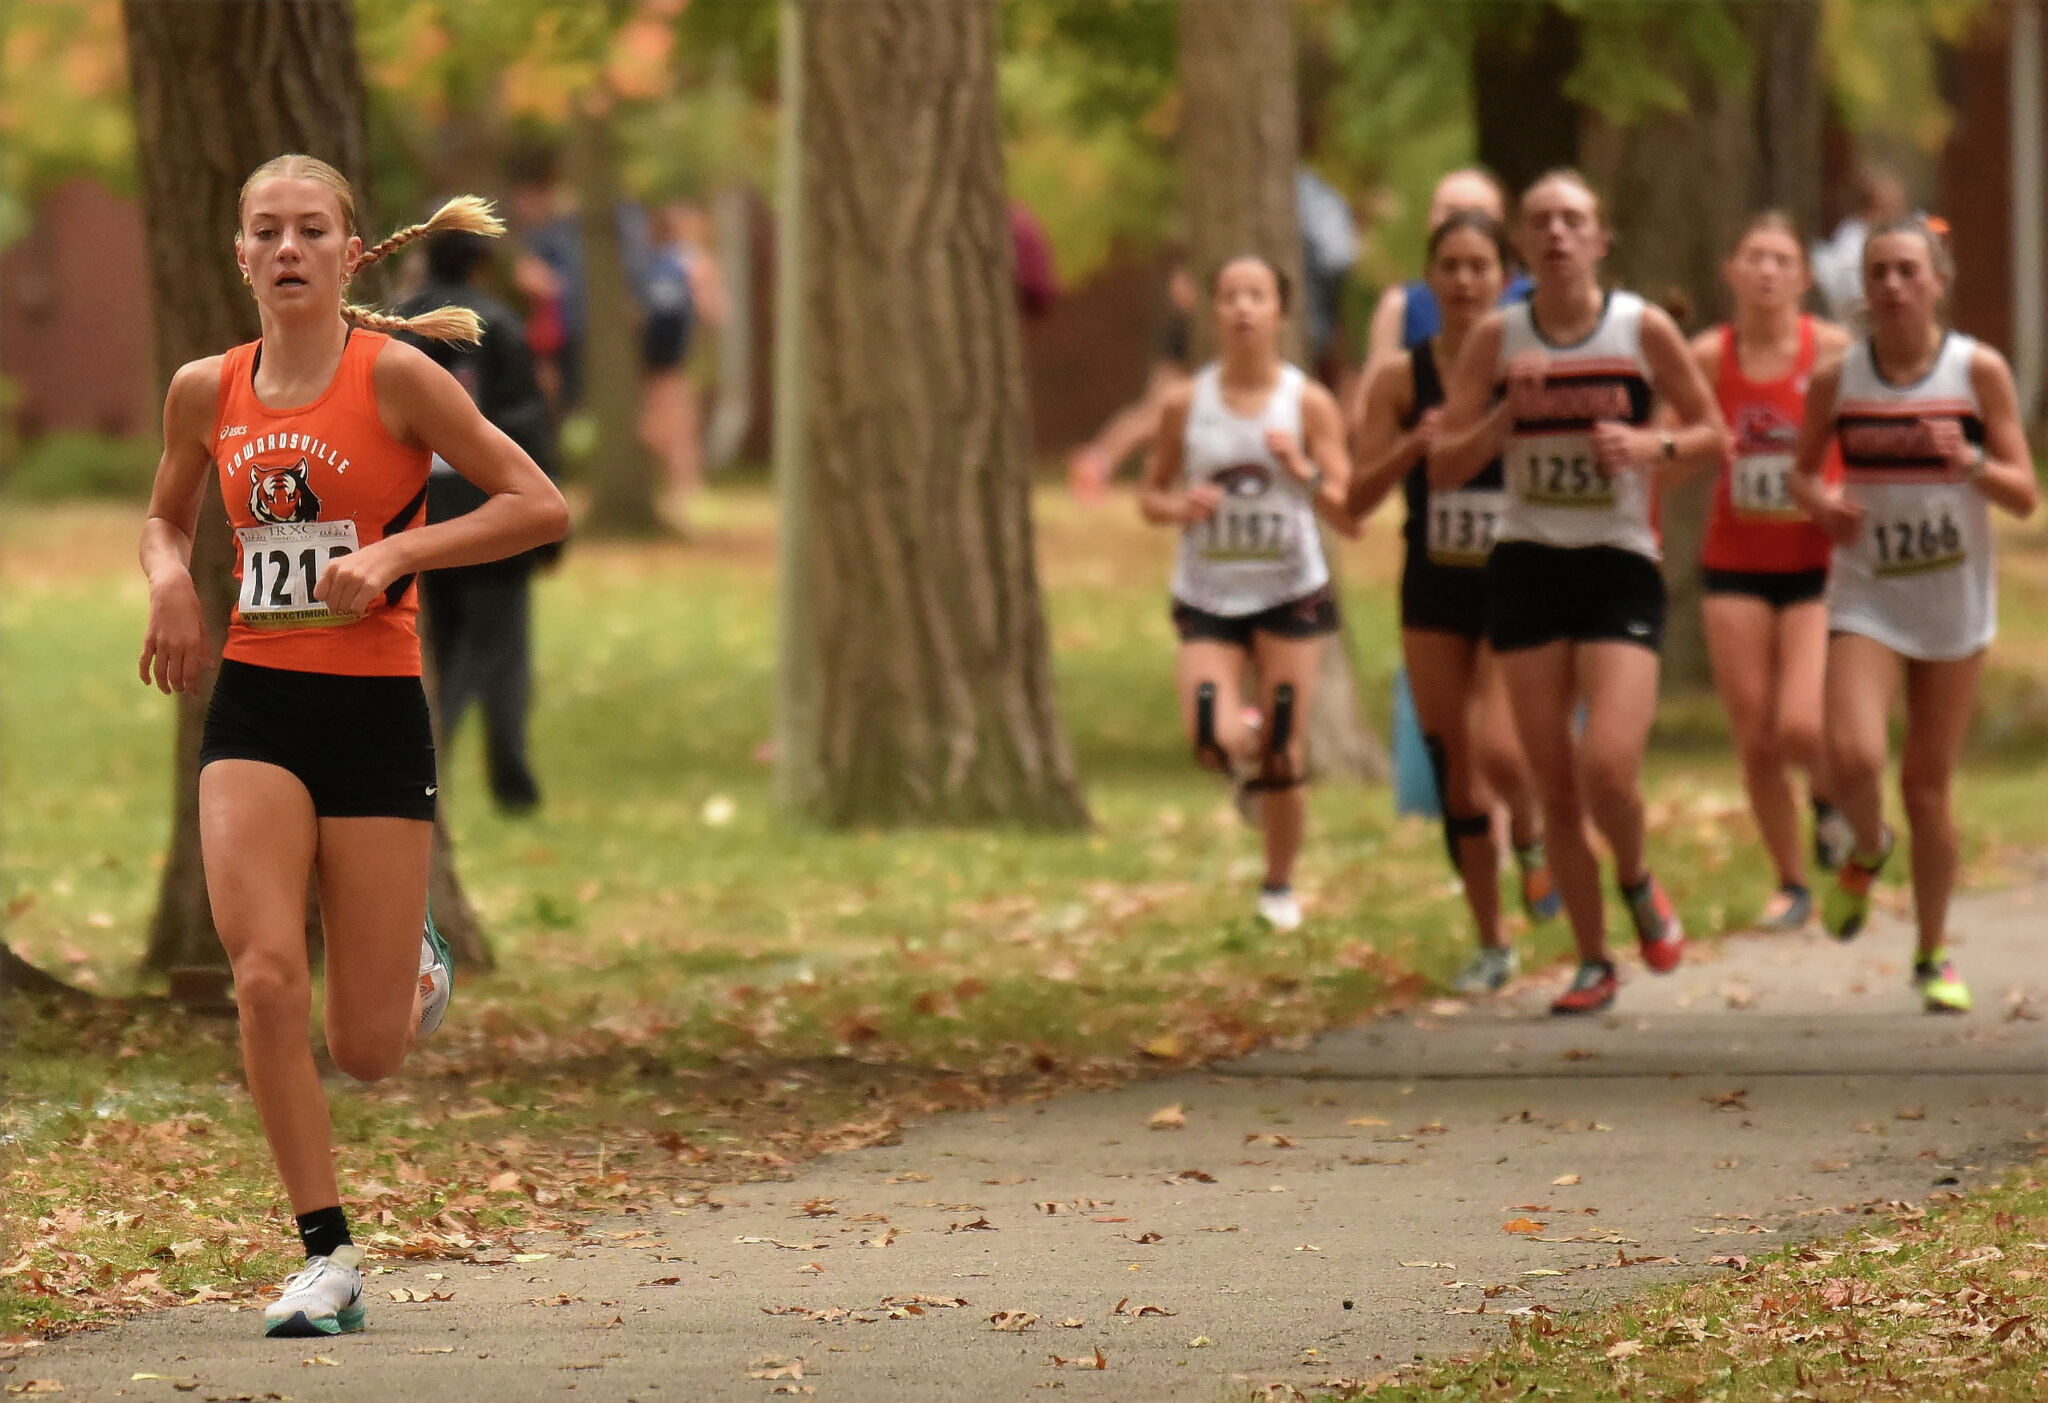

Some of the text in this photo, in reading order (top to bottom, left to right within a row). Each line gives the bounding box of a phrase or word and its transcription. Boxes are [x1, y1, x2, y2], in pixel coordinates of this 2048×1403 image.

[227, 433, 350, 477] EDWARDSVILLE
[1874, 511, 1960, 561] 1266
[252, 546, 353, 606] 121
